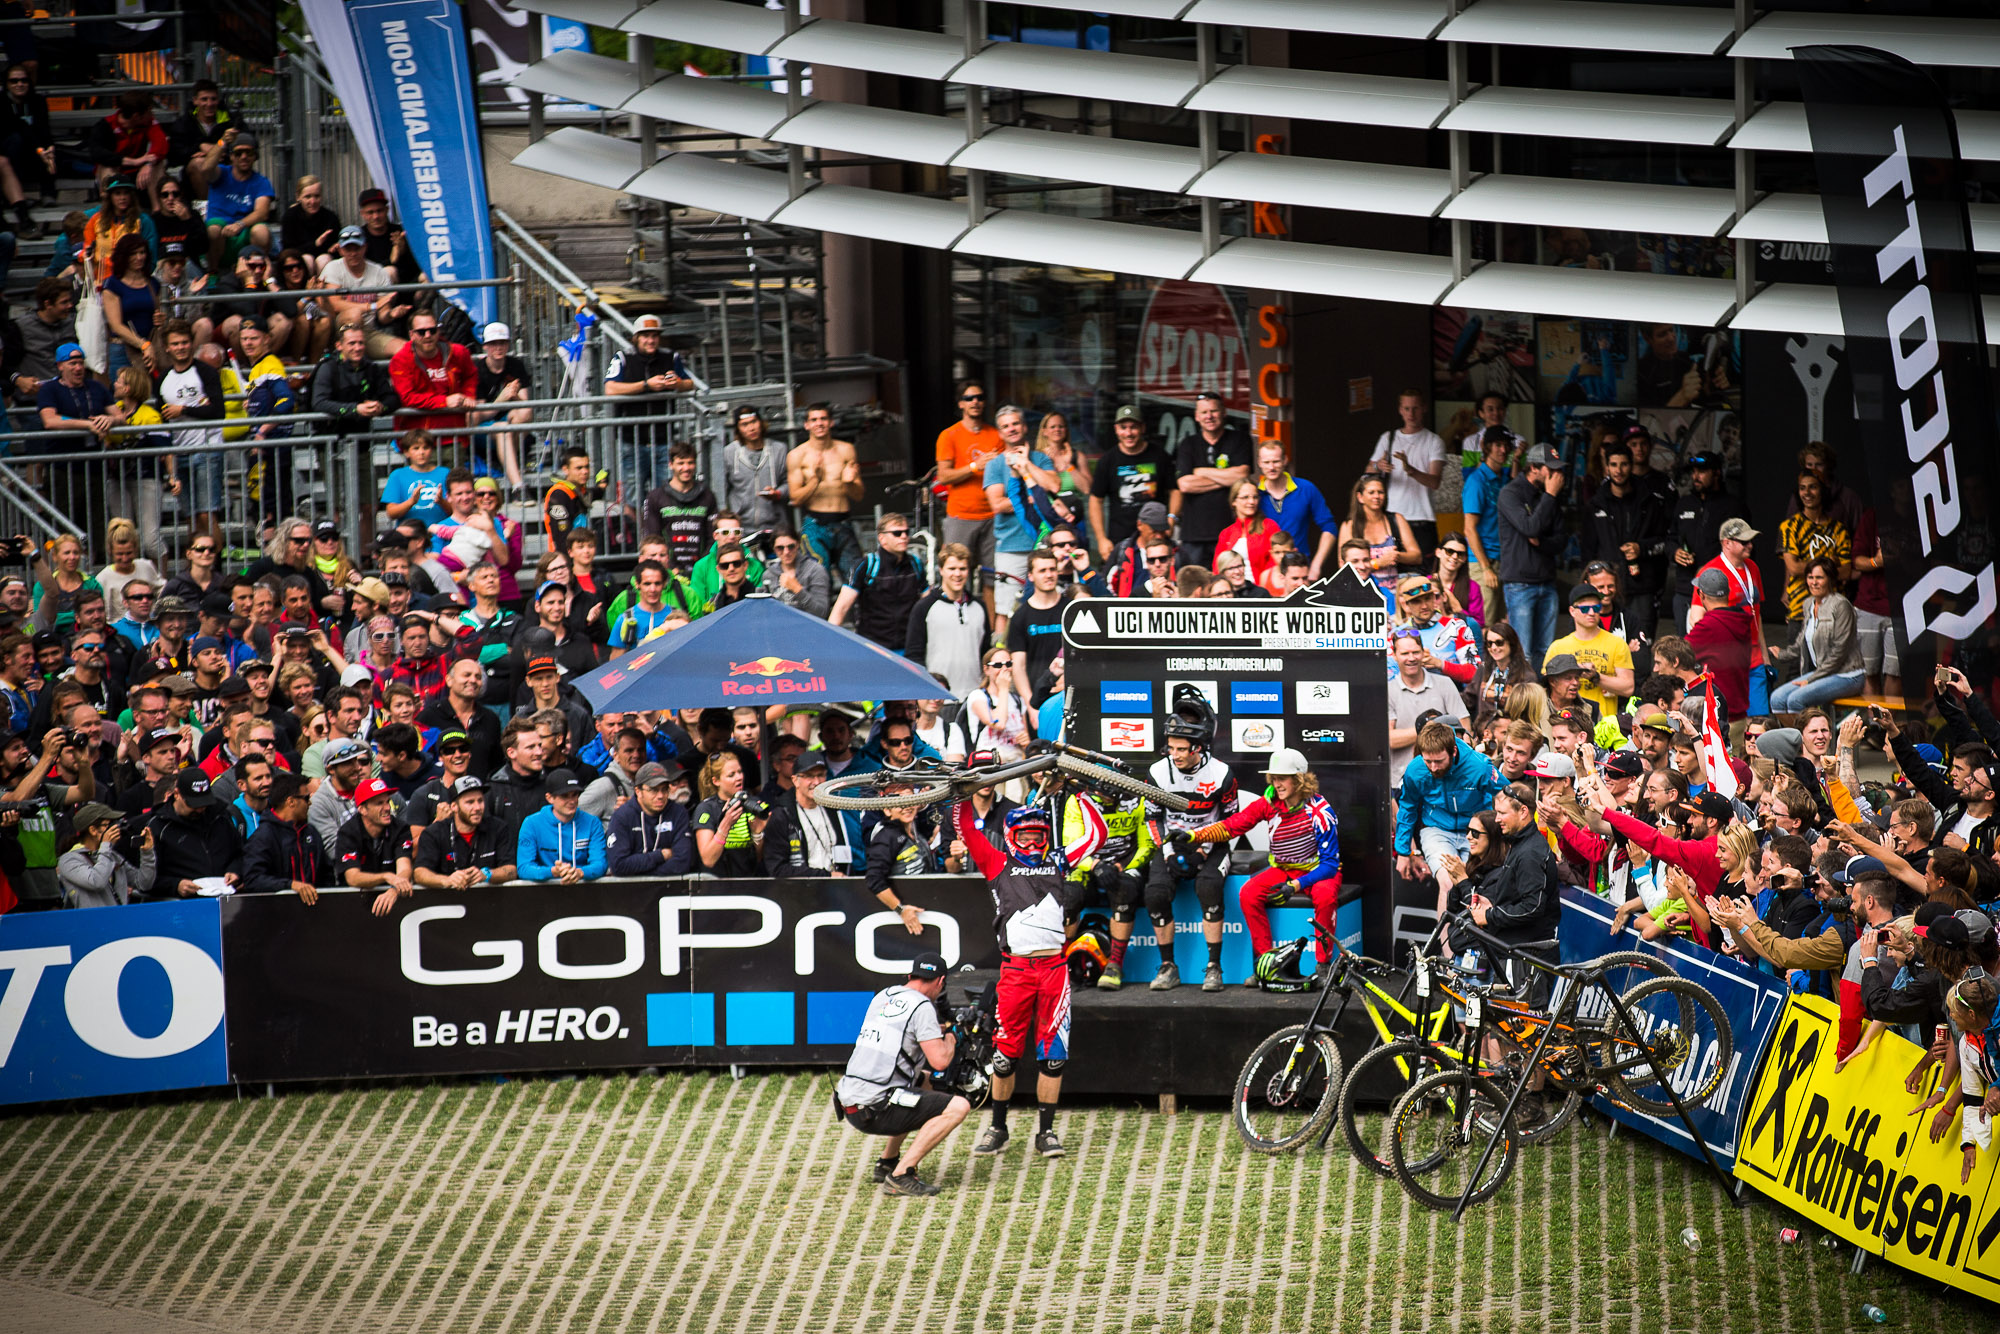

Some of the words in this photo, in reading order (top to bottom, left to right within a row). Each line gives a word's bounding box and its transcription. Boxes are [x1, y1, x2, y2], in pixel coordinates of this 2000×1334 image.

[1143, 321, 1239, 400] SPORT
[1115, 611, 1143, 634] UCI
[1149, 611, 1237, 634] MOUNTAIN
[1241, 611, 1279, 634] BIKE
[1286, 611, 1346, 634] WORLD
[1351, 612, 1386, 634] CUP
[1263, 637, 1302, 648] PRESENTED
[1302, 638, 1312, 648] BY
[1315, 637, 1385, 648] SHIMANO
[1166, 657, 1206, 672] LEOGANG
[1207, 657, 1283, 672] SALZBURGERLAND
[721, 679, 774, 696] Red
[776, 676, 828, 693] Bull
[1104, 693, 1149, 701] SHIMANO
[1235, 693, 1279, 702] SHIMANO
[1301, 729, 1345, 737] GoPro
[400, 895, 960, 986] GoPro
[413, 1015, 458, 1047] Be
[465, 1022, 487, 1045] a
[494, 1005, 630, 1044] HERO.
[1783, 1092, 1972, 1268] Raiffeisen
